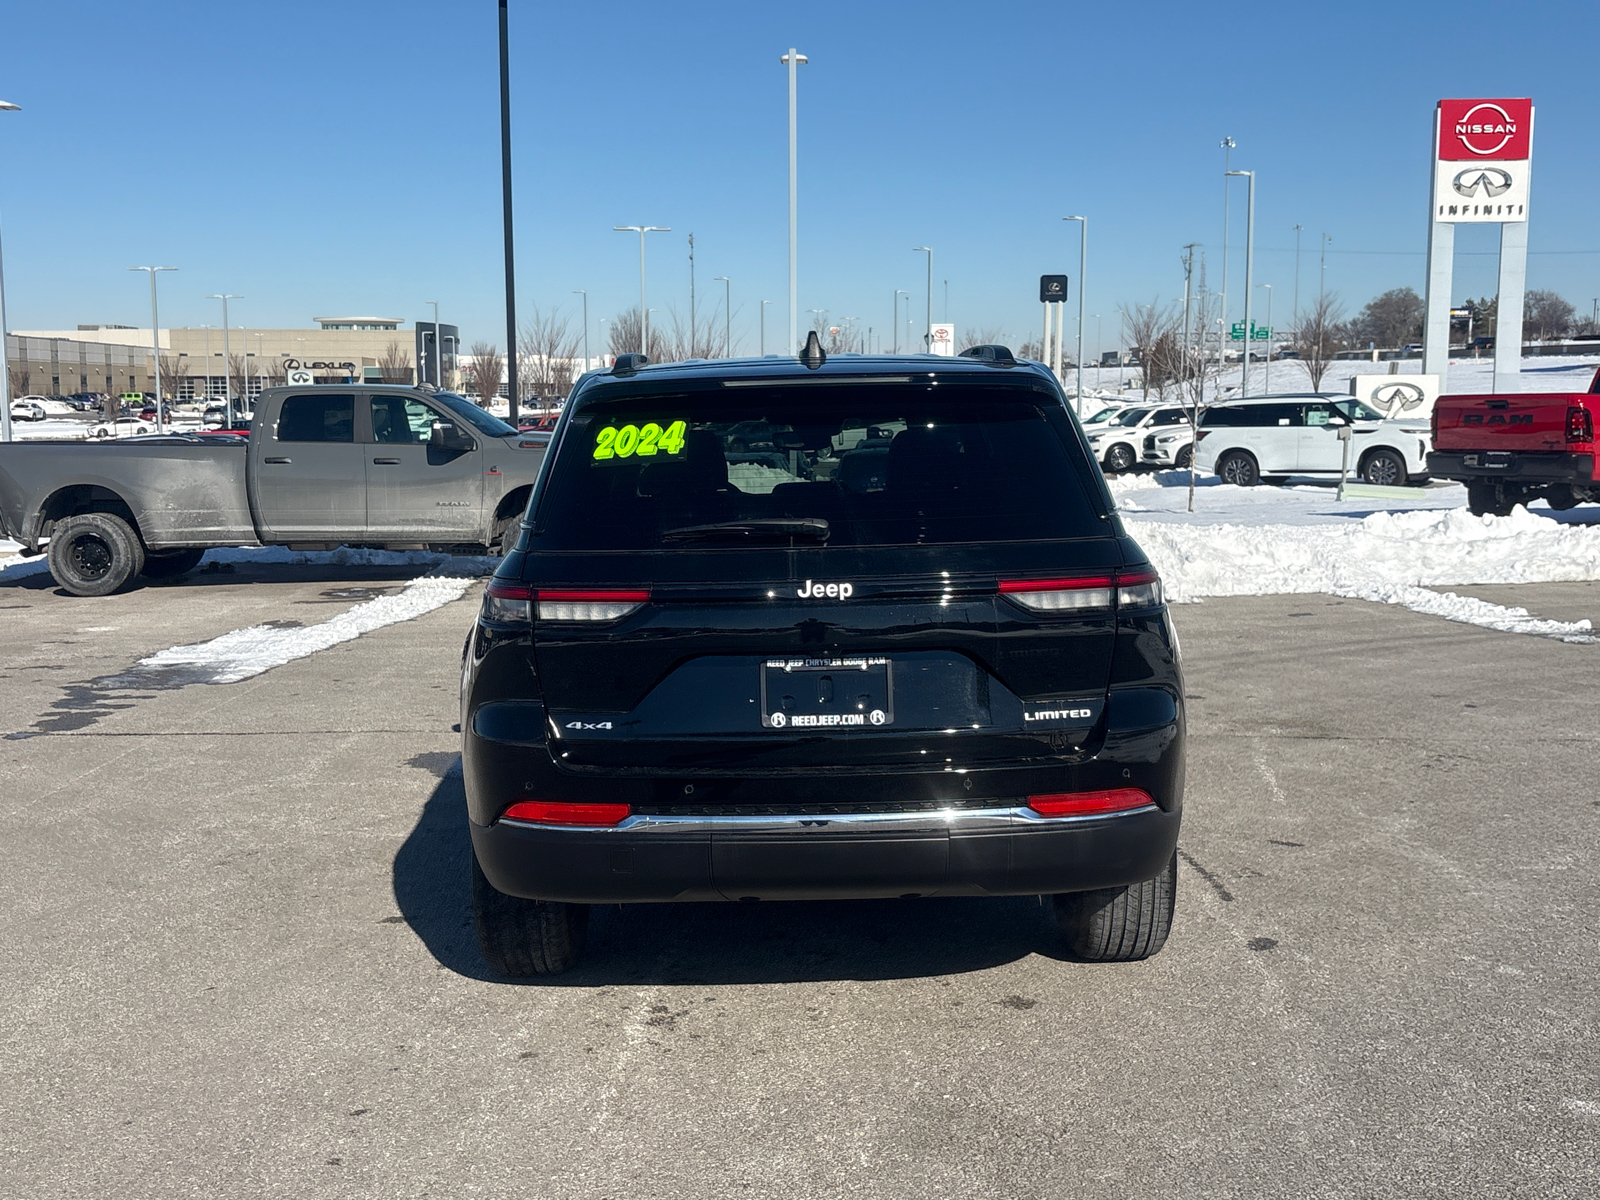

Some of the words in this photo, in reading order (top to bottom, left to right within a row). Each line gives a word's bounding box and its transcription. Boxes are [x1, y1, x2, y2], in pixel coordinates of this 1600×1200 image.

[1456, 124, 1516, 133] NISSAN
[1439, 204, 1523, 216] INFINITI
[1463, 414, 1534, 425] RAM
[593, 420, 687, 460] 2024
[797, 579, 853, 600] Jeep
[787, 659, 804, 667] JEEP
[805, 658, 841, 667] CHRYSLER
[843, 657, 867, 666] DODGE
[868, 657, 885, 665] RAM
[791, 714, 864, 726] REEDJEEP.COM
[1024, 709, 1091, 721] LIMITED
[565, 721, 613, 730] 4x4
